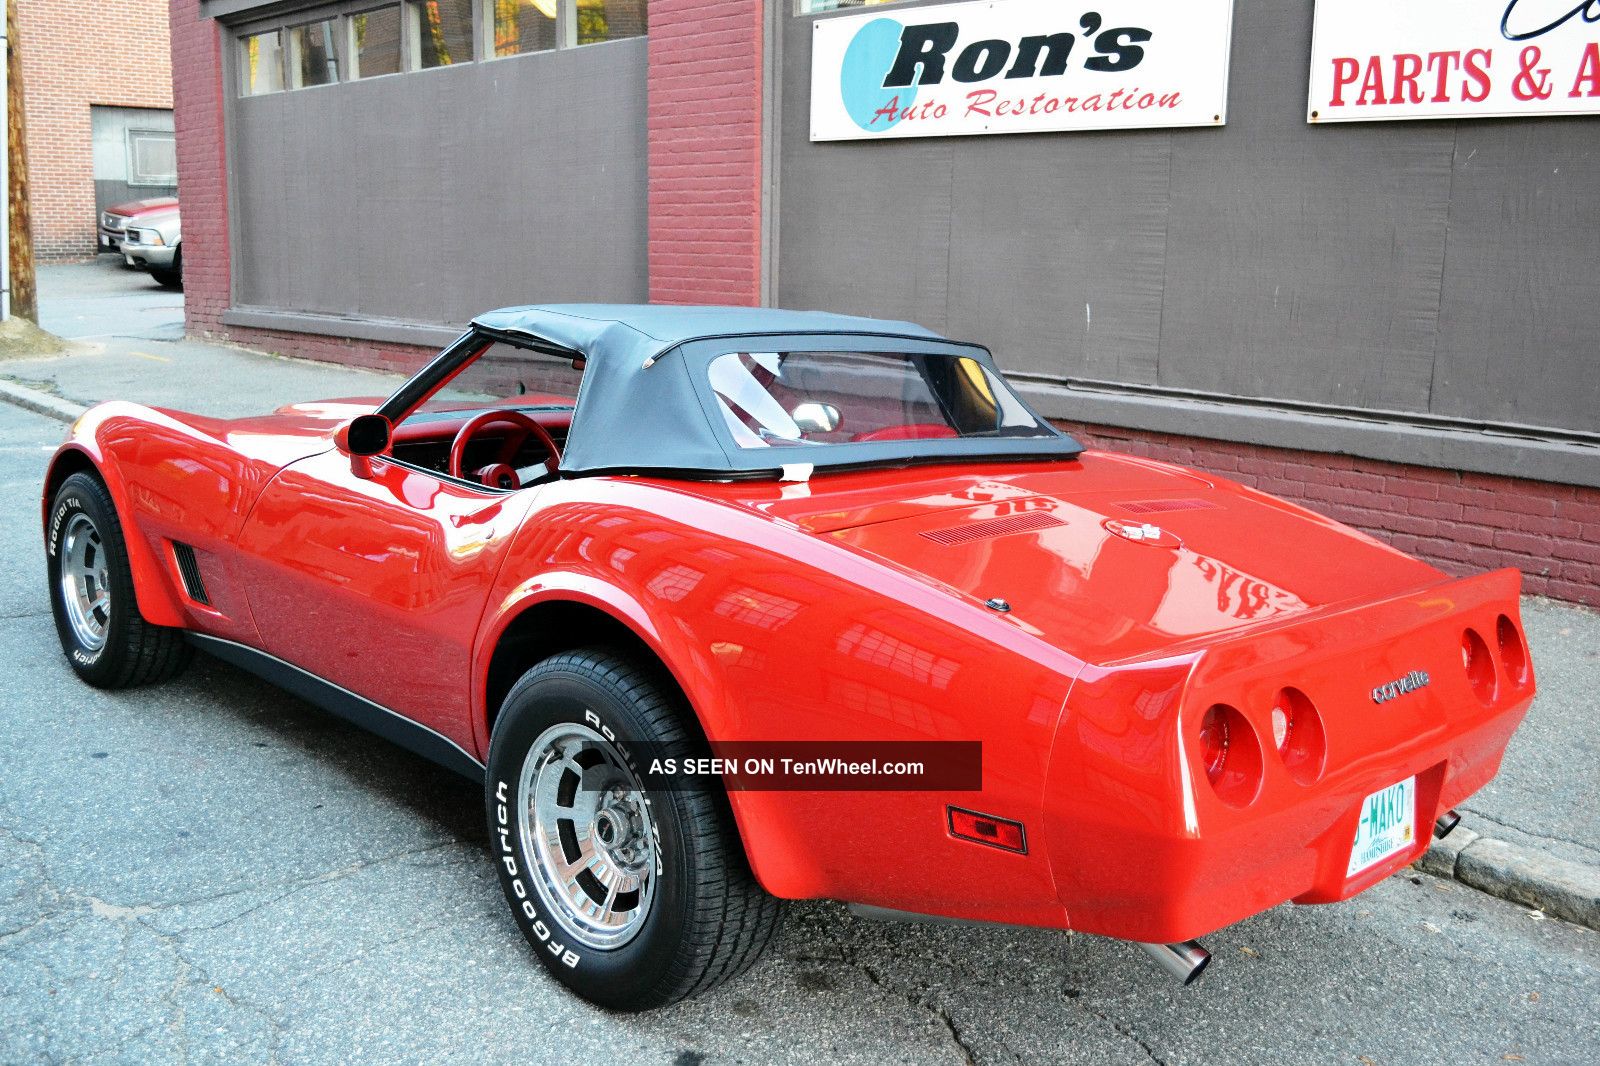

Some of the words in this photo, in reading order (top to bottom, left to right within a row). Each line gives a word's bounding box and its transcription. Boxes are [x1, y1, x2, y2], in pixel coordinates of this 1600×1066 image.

[885, 12, 1152, 87] Ron's
[1329, 48, 1492, 106] PARTS
[1511, 45, 1553, 100] &
[870, 100, 948, 124] Auto
[965, 88, 1182, 118] Restoration
[50, 503, 67, 556] Radial
[496, 781, 580, 969] BFGoodrich
